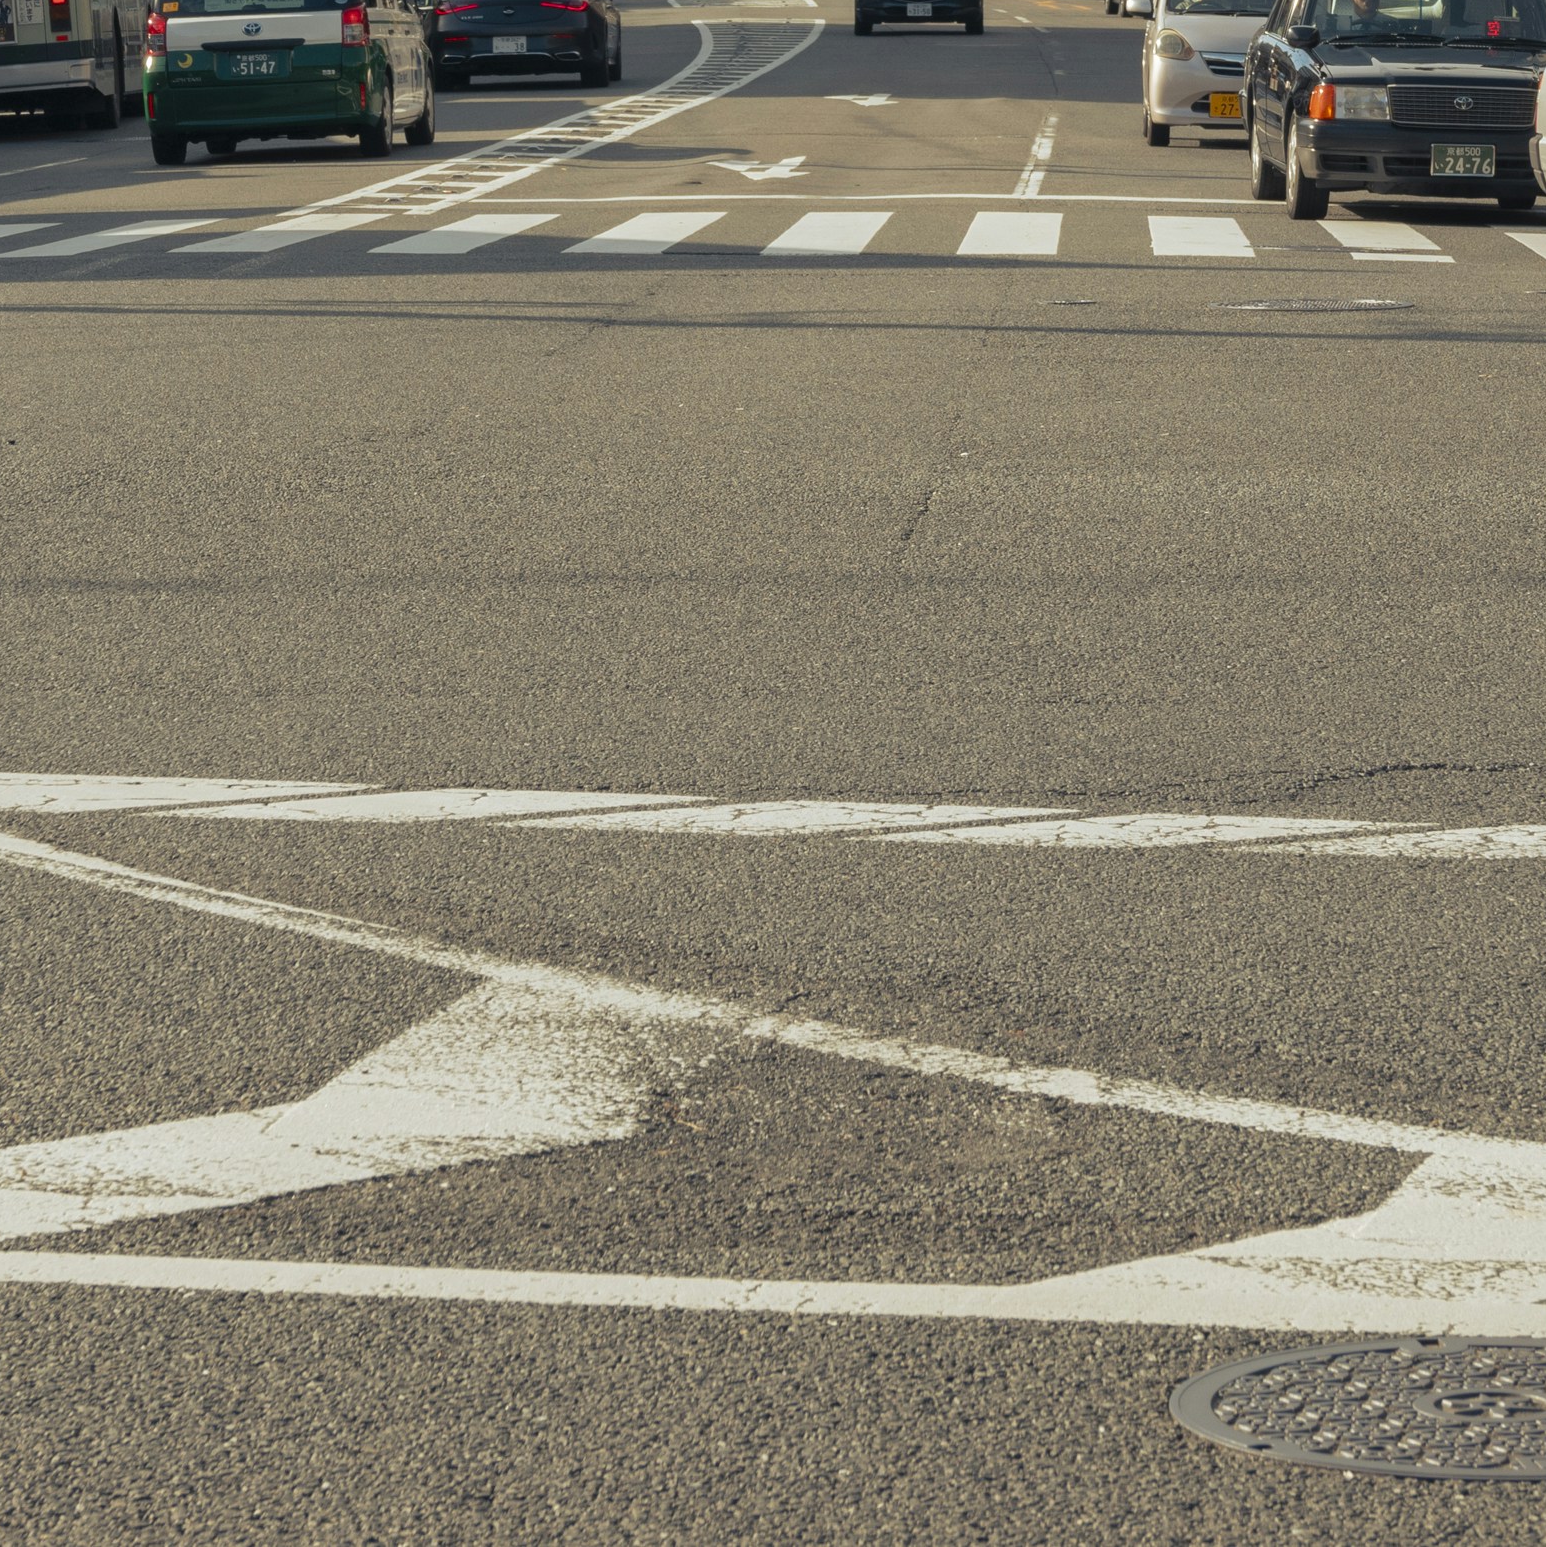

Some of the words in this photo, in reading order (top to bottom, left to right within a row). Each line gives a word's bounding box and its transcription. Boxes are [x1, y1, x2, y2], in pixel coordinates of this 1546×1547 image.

[240, 61, 276, 75] 51-47
[1446, 147, 1481, 156] 京都500
[1445, 157, 1491, 174] 24-76
